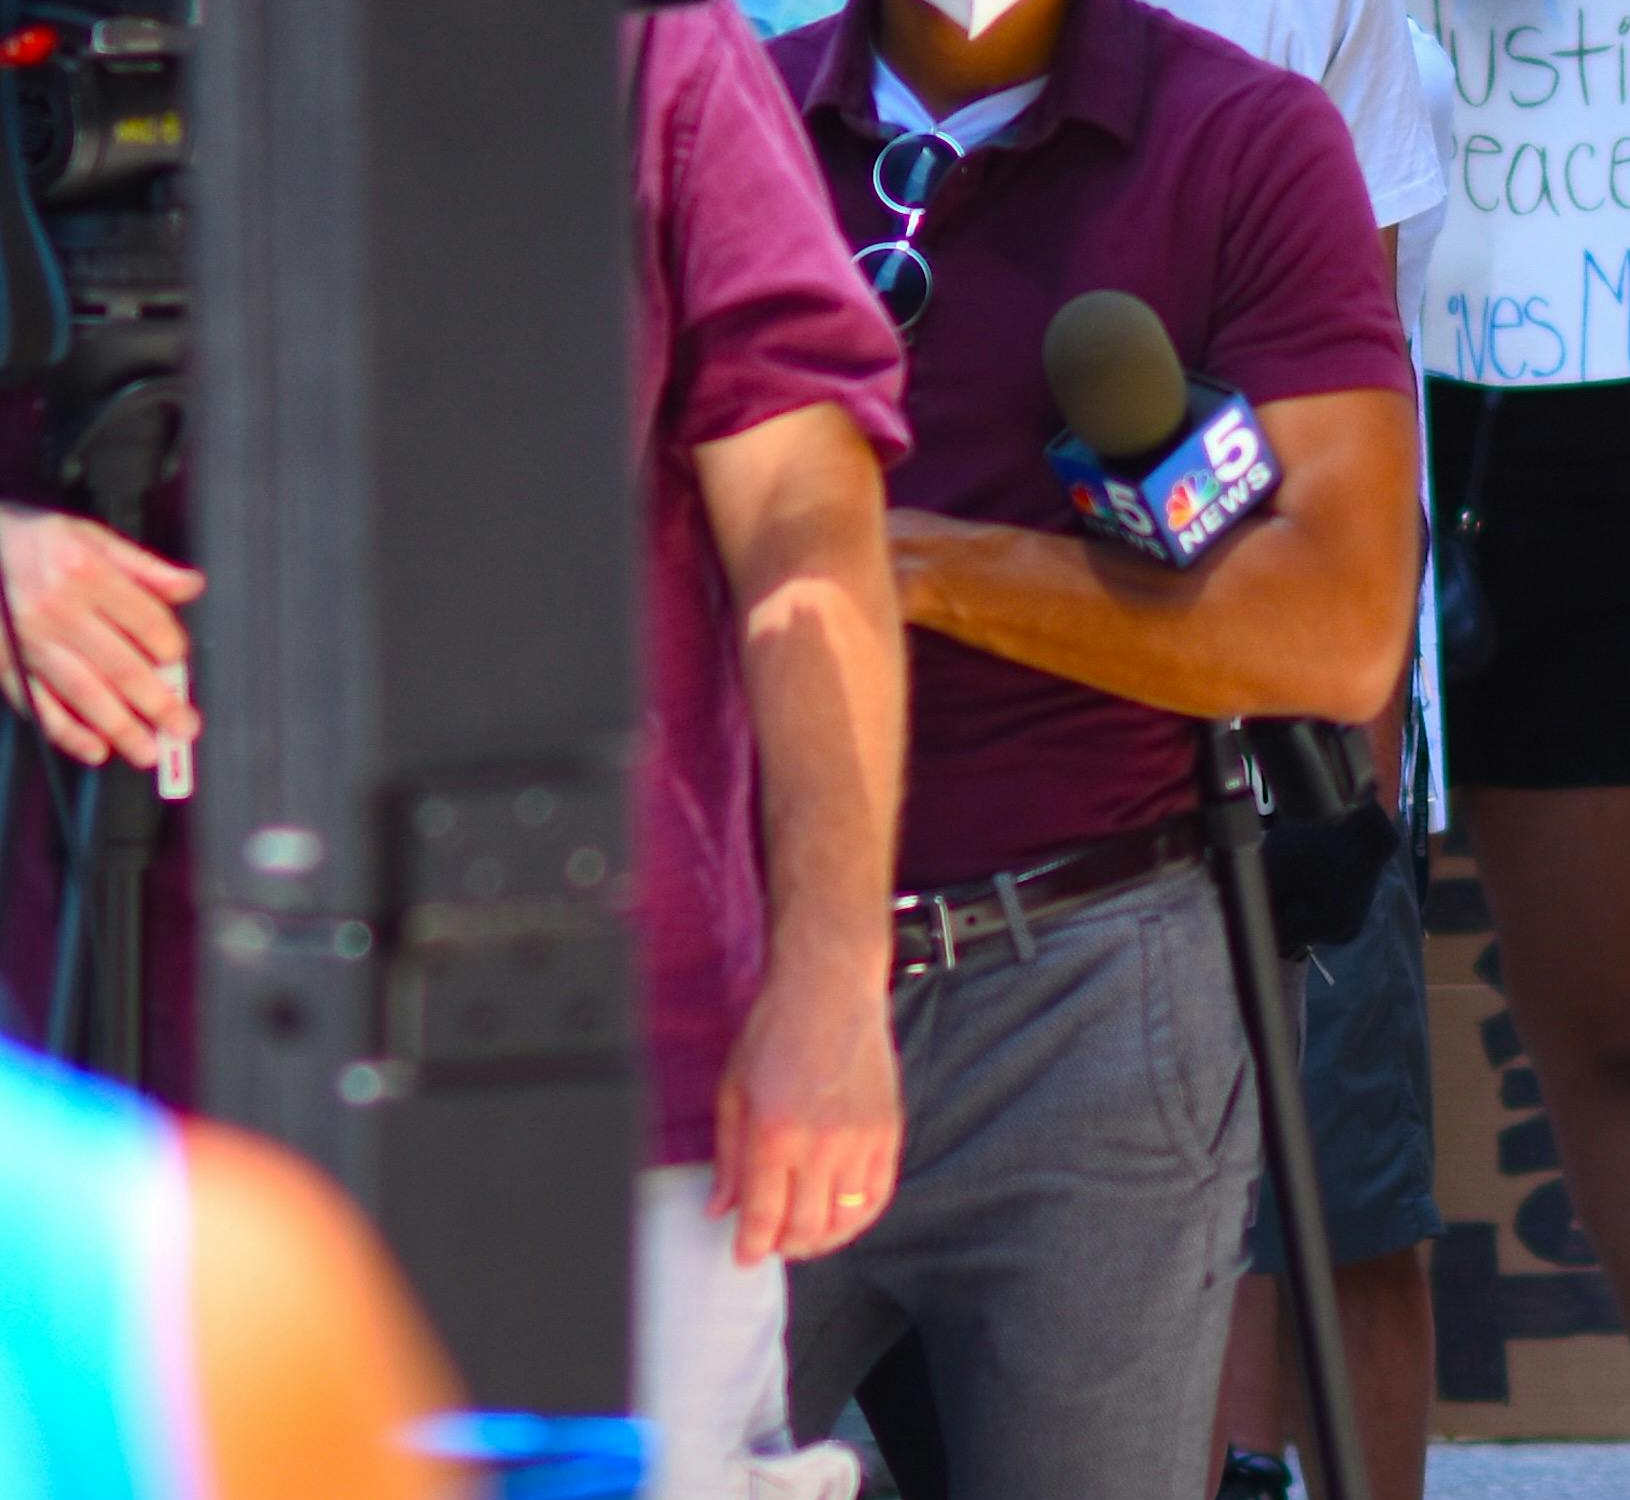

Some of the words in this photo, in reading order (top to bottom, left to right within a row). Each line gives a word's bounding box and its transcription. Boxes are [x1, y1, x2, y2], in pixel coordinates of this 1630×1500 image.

[1446, 290, 1568, 380] ives
[1203, 409, 1258, 483] 5
[1103, 480, 1154, 537] 5
[1177, 461, 1272, 555] NEWS
